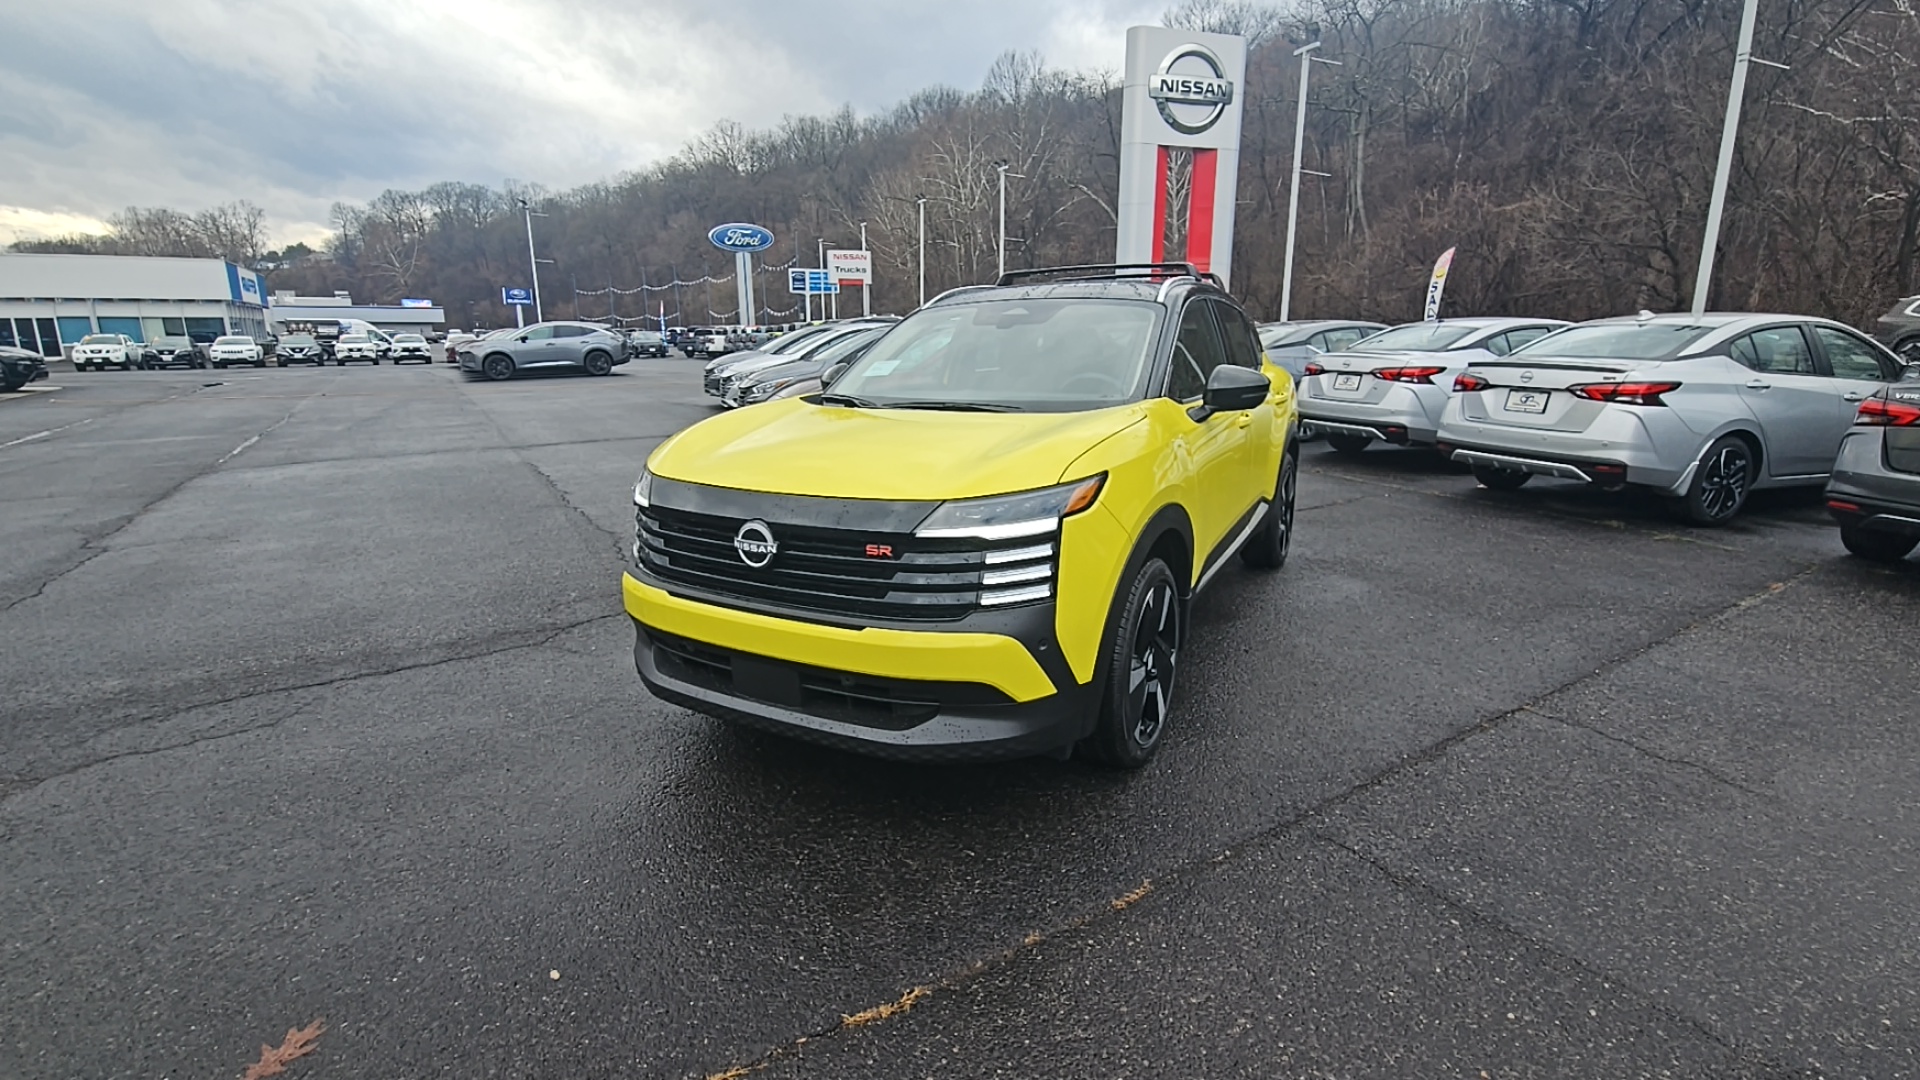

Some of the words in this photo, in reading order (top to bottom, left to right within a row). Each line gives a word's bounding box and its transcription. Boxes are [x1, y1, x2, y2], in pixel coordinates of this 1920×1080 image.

[1159, 79, 1227, 98] NISSAN
[724, 229, 762, 246] Ford
[833, 253, 867, 261] NISSAN
[834, 265, 867, 274] Trucks
[734, 537, 779, 554] NISSAN
[865, 544, 893, 557] SR
